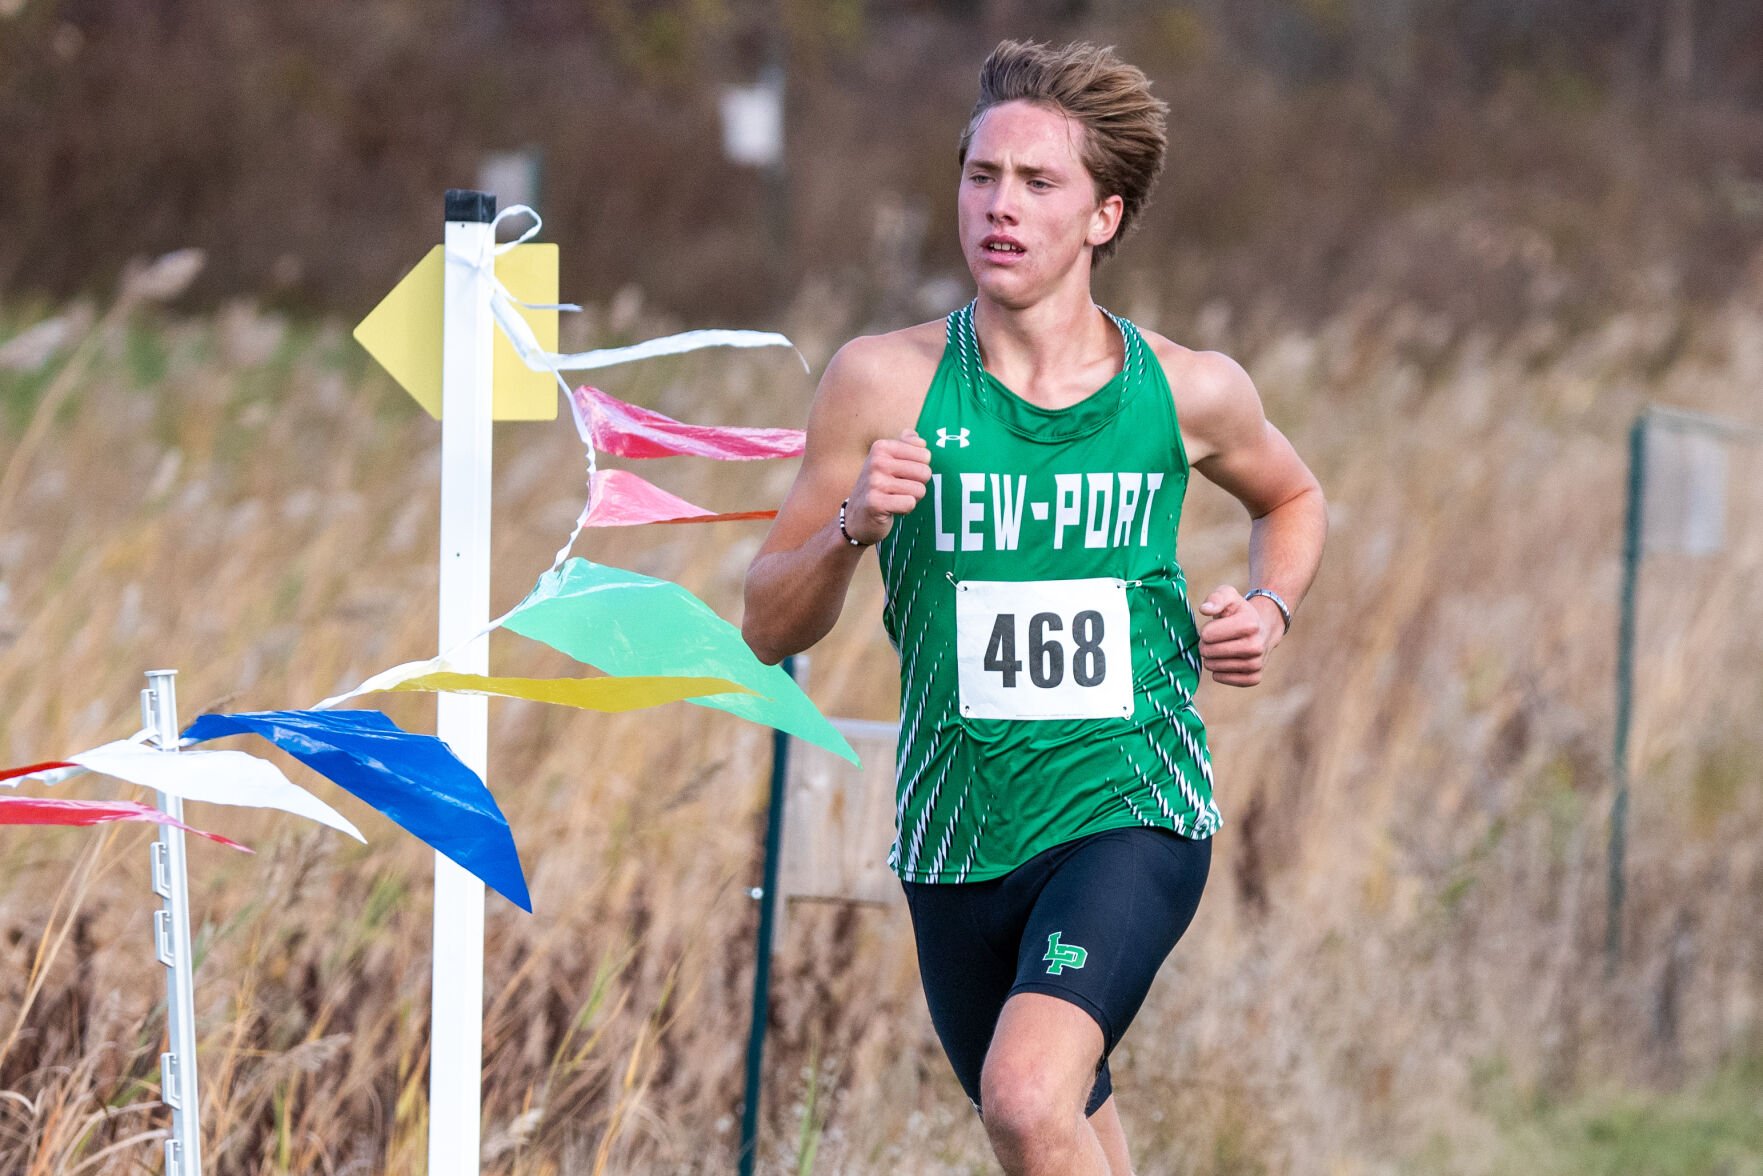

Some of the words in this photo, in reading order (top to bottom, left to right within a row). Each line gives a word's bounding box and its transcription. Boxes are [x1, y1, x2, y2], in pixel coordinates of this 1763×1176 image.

[932, 472, 1164, 552] LEW-PORT
[984, 610, 1106, 688] 468
[1042, 931, 1088, 975] LP
